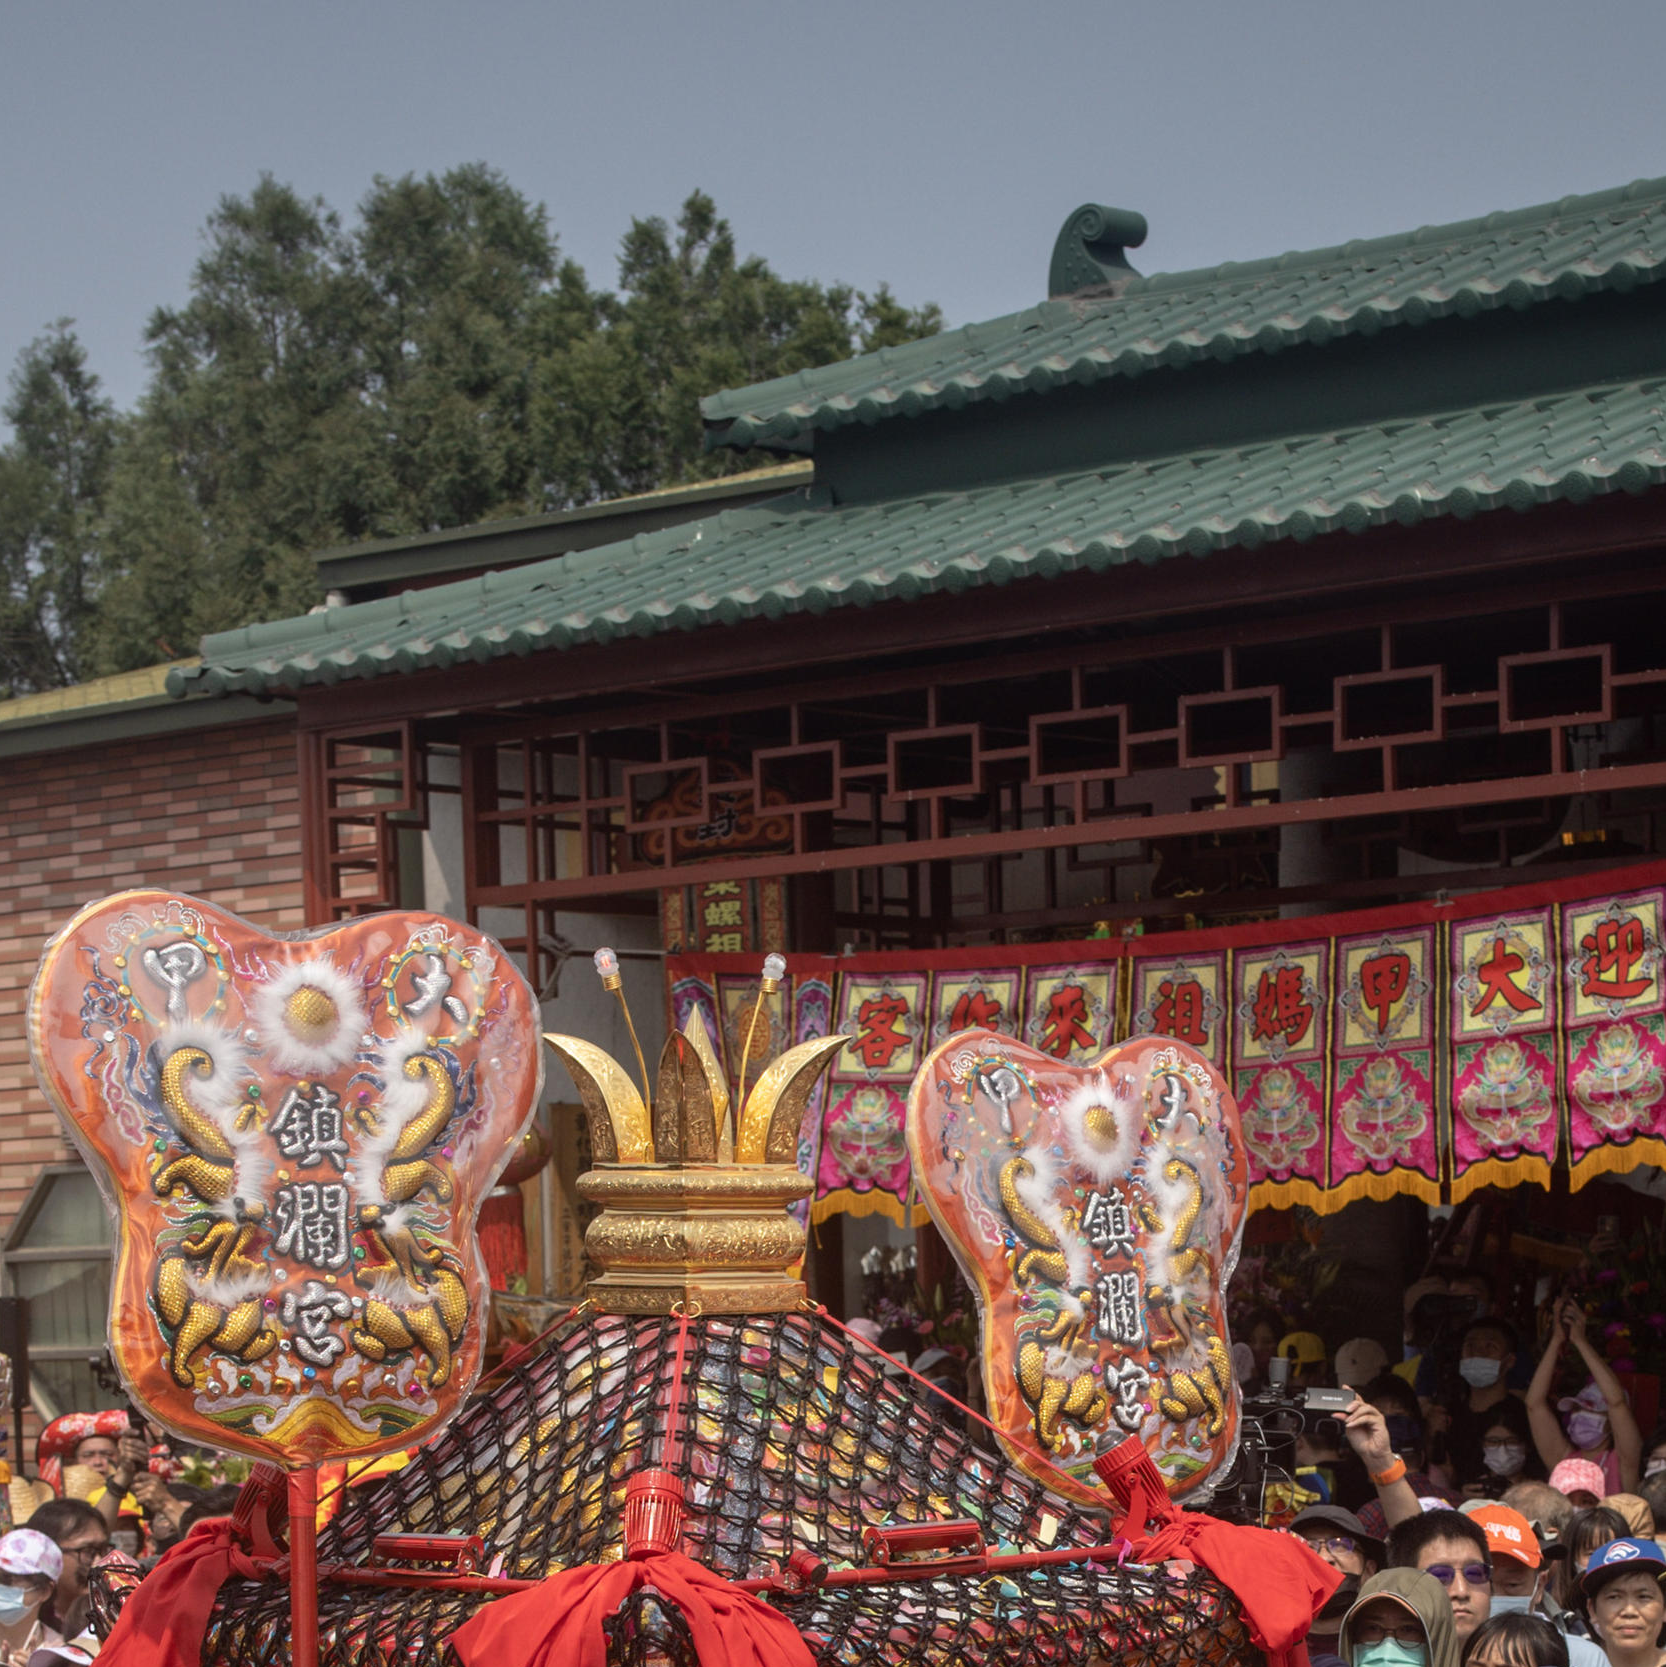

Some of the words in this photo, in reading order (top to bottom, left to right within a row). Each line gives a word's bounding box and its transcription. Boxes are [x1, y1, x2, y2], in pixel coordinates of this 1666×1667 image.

[270, 1082, 353, 1368] 鎮瀾宮
[1084, 1189, 1150, 1429] 鎮瀾宮
